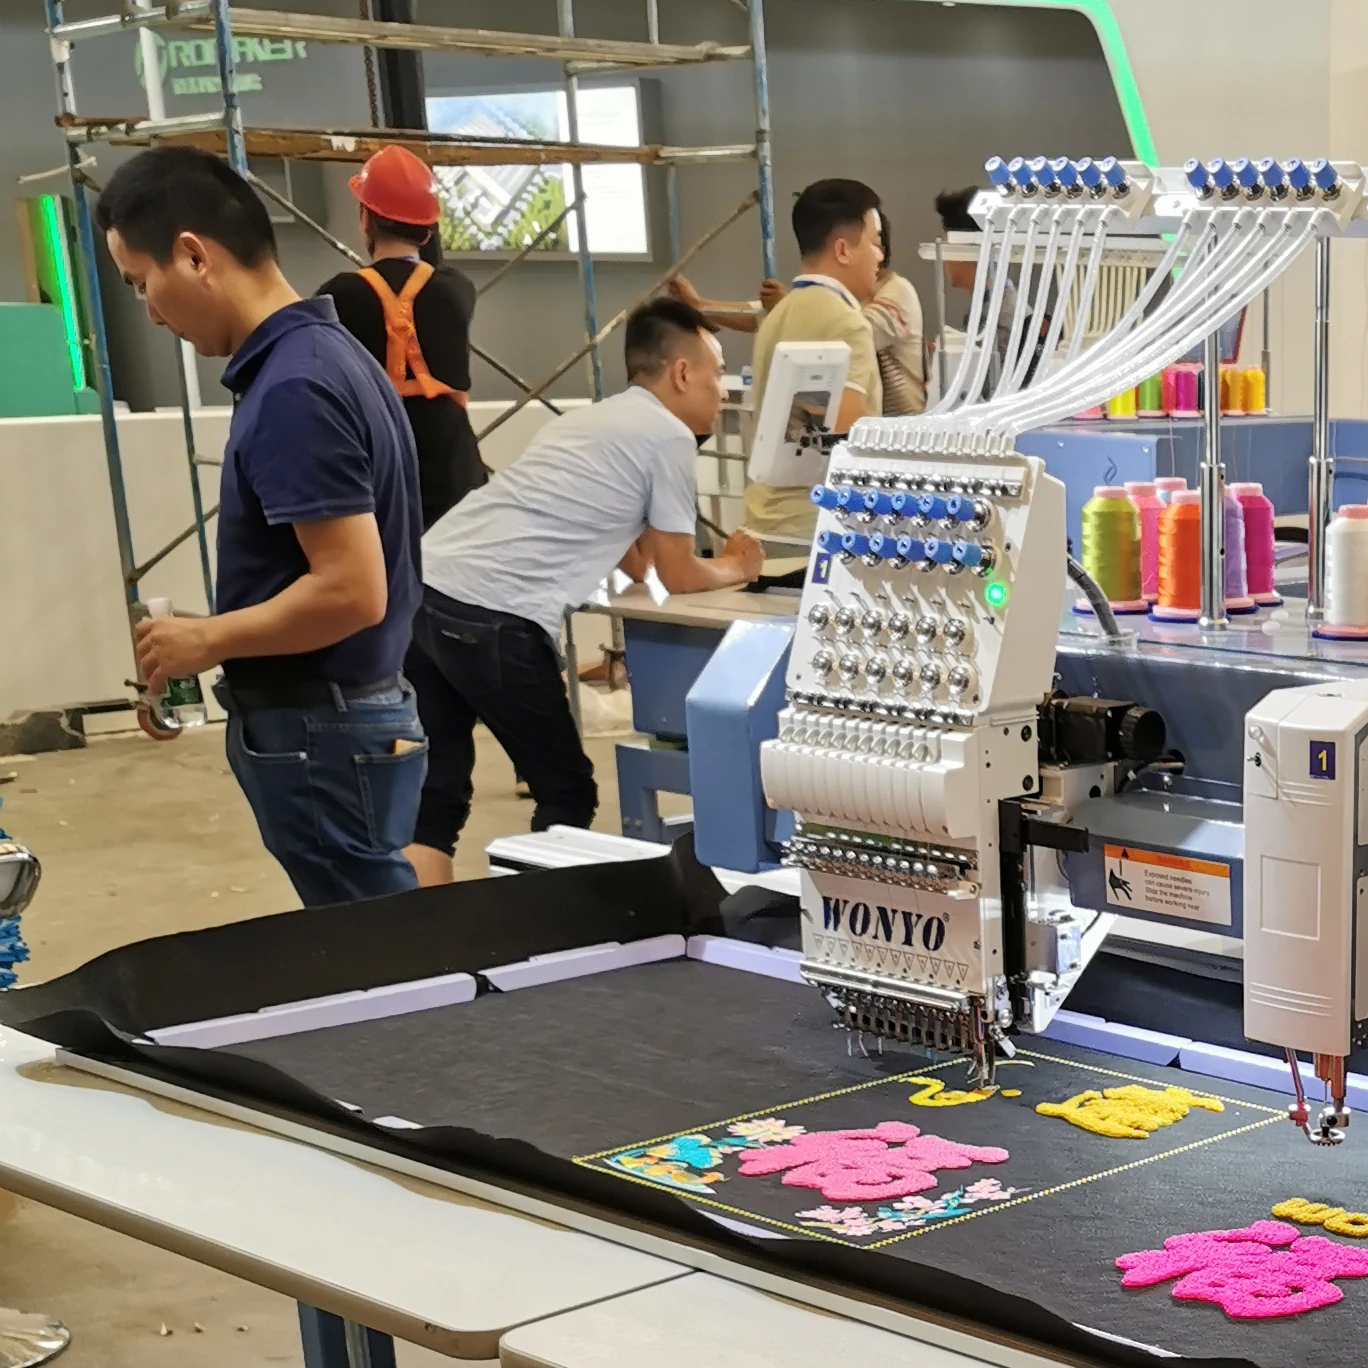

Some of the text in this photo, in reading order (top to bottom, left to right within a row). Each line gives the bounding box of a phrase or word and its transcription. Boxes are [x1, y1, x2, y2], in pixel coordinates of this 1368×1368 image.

[1318, 750, 1327, 771] 1
[1144, 868, 1192, 885] Exposed needles
[1145, 886, 1193, 901] Stop the machine
[1156, 881, 1173, 889] cause
[1174, 884, 1193, 893] severe
[1145, 894, 1163, 904] before
[1164, 899, 1187, 909] working
[822, 895, 945, 951] WONYO
